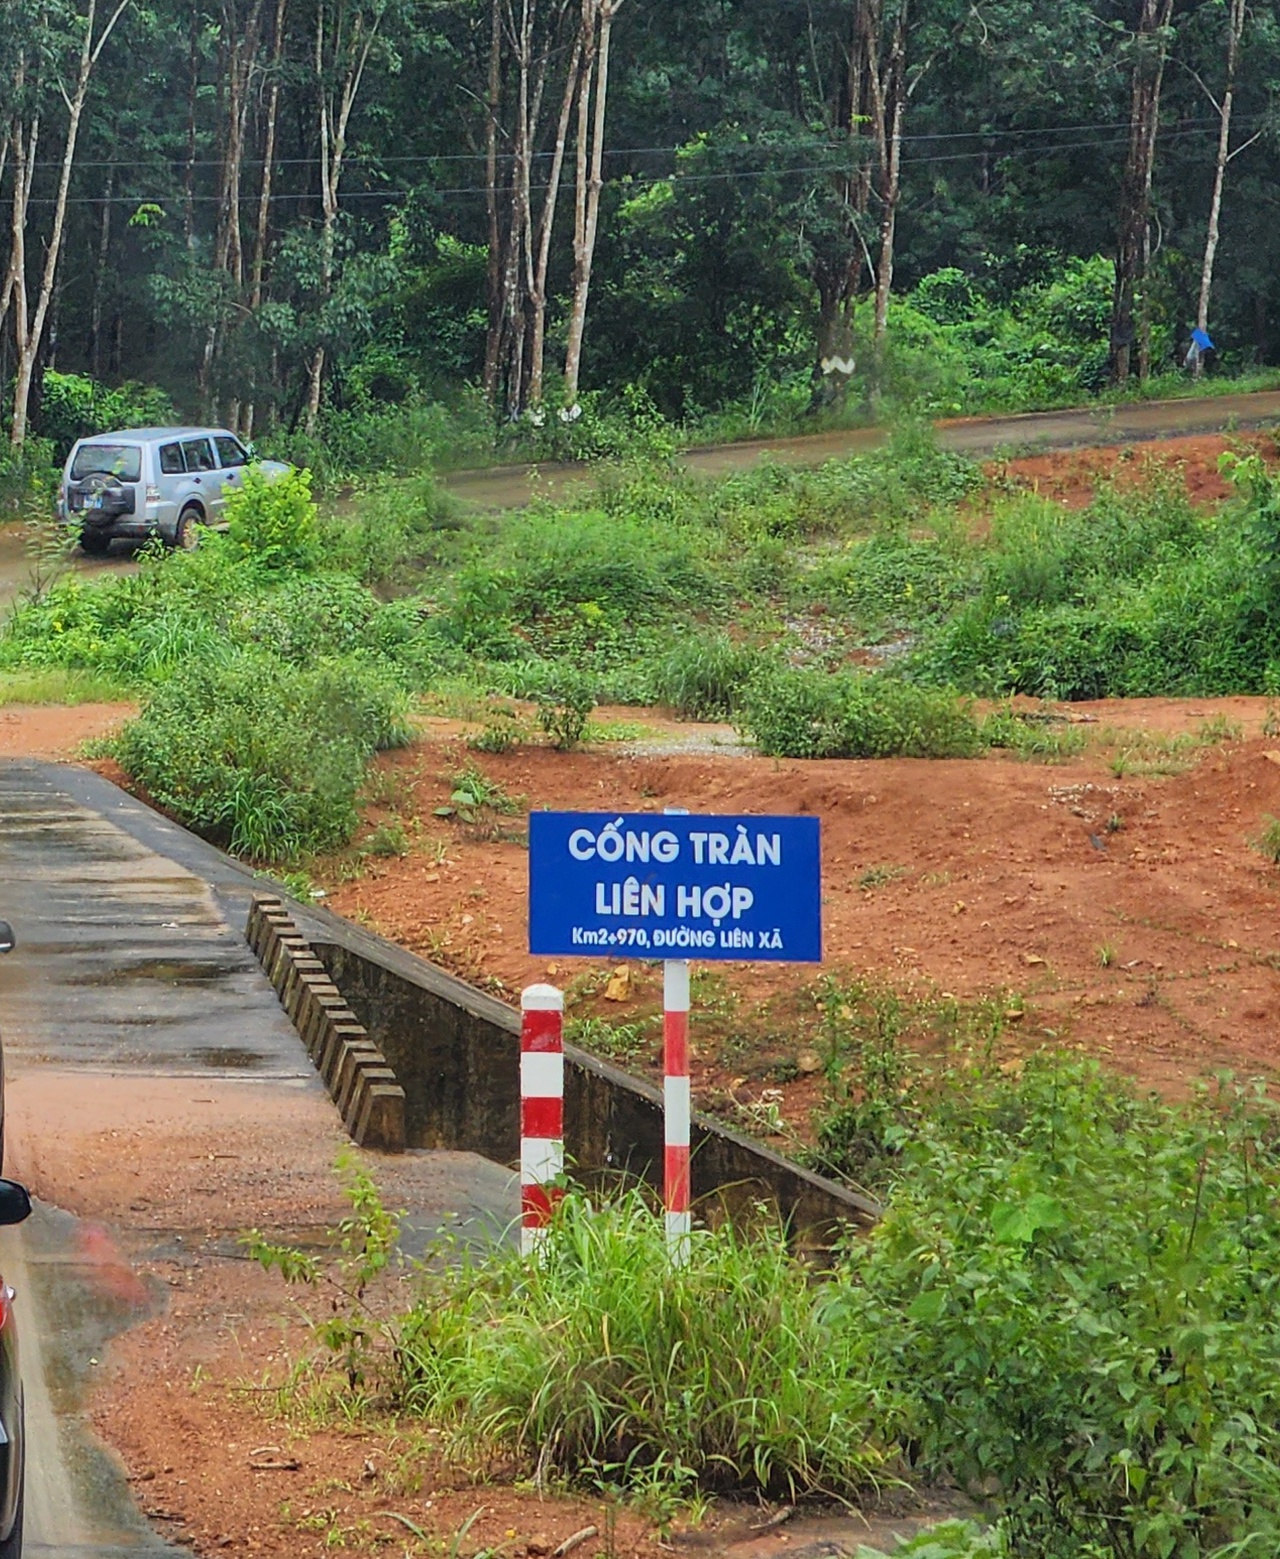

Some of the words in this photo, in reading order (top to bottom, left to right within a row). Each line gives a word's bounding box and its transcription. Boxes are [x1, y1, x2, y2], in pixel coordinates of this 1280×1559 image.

[568, 816, 680, 863] CỐNG
[689, 824, 781, 866] TRÀN
[595, 876, 665, 917] LIÊN
[677, 882, 754, 927] HỢP
[572, 927, 651, 949] Km2+970,
[653, 926, 716, 948] ĐƯỜNG
[720, 928, 754, 949] LIÊN
[758, 928, 783, 949] XÃ
